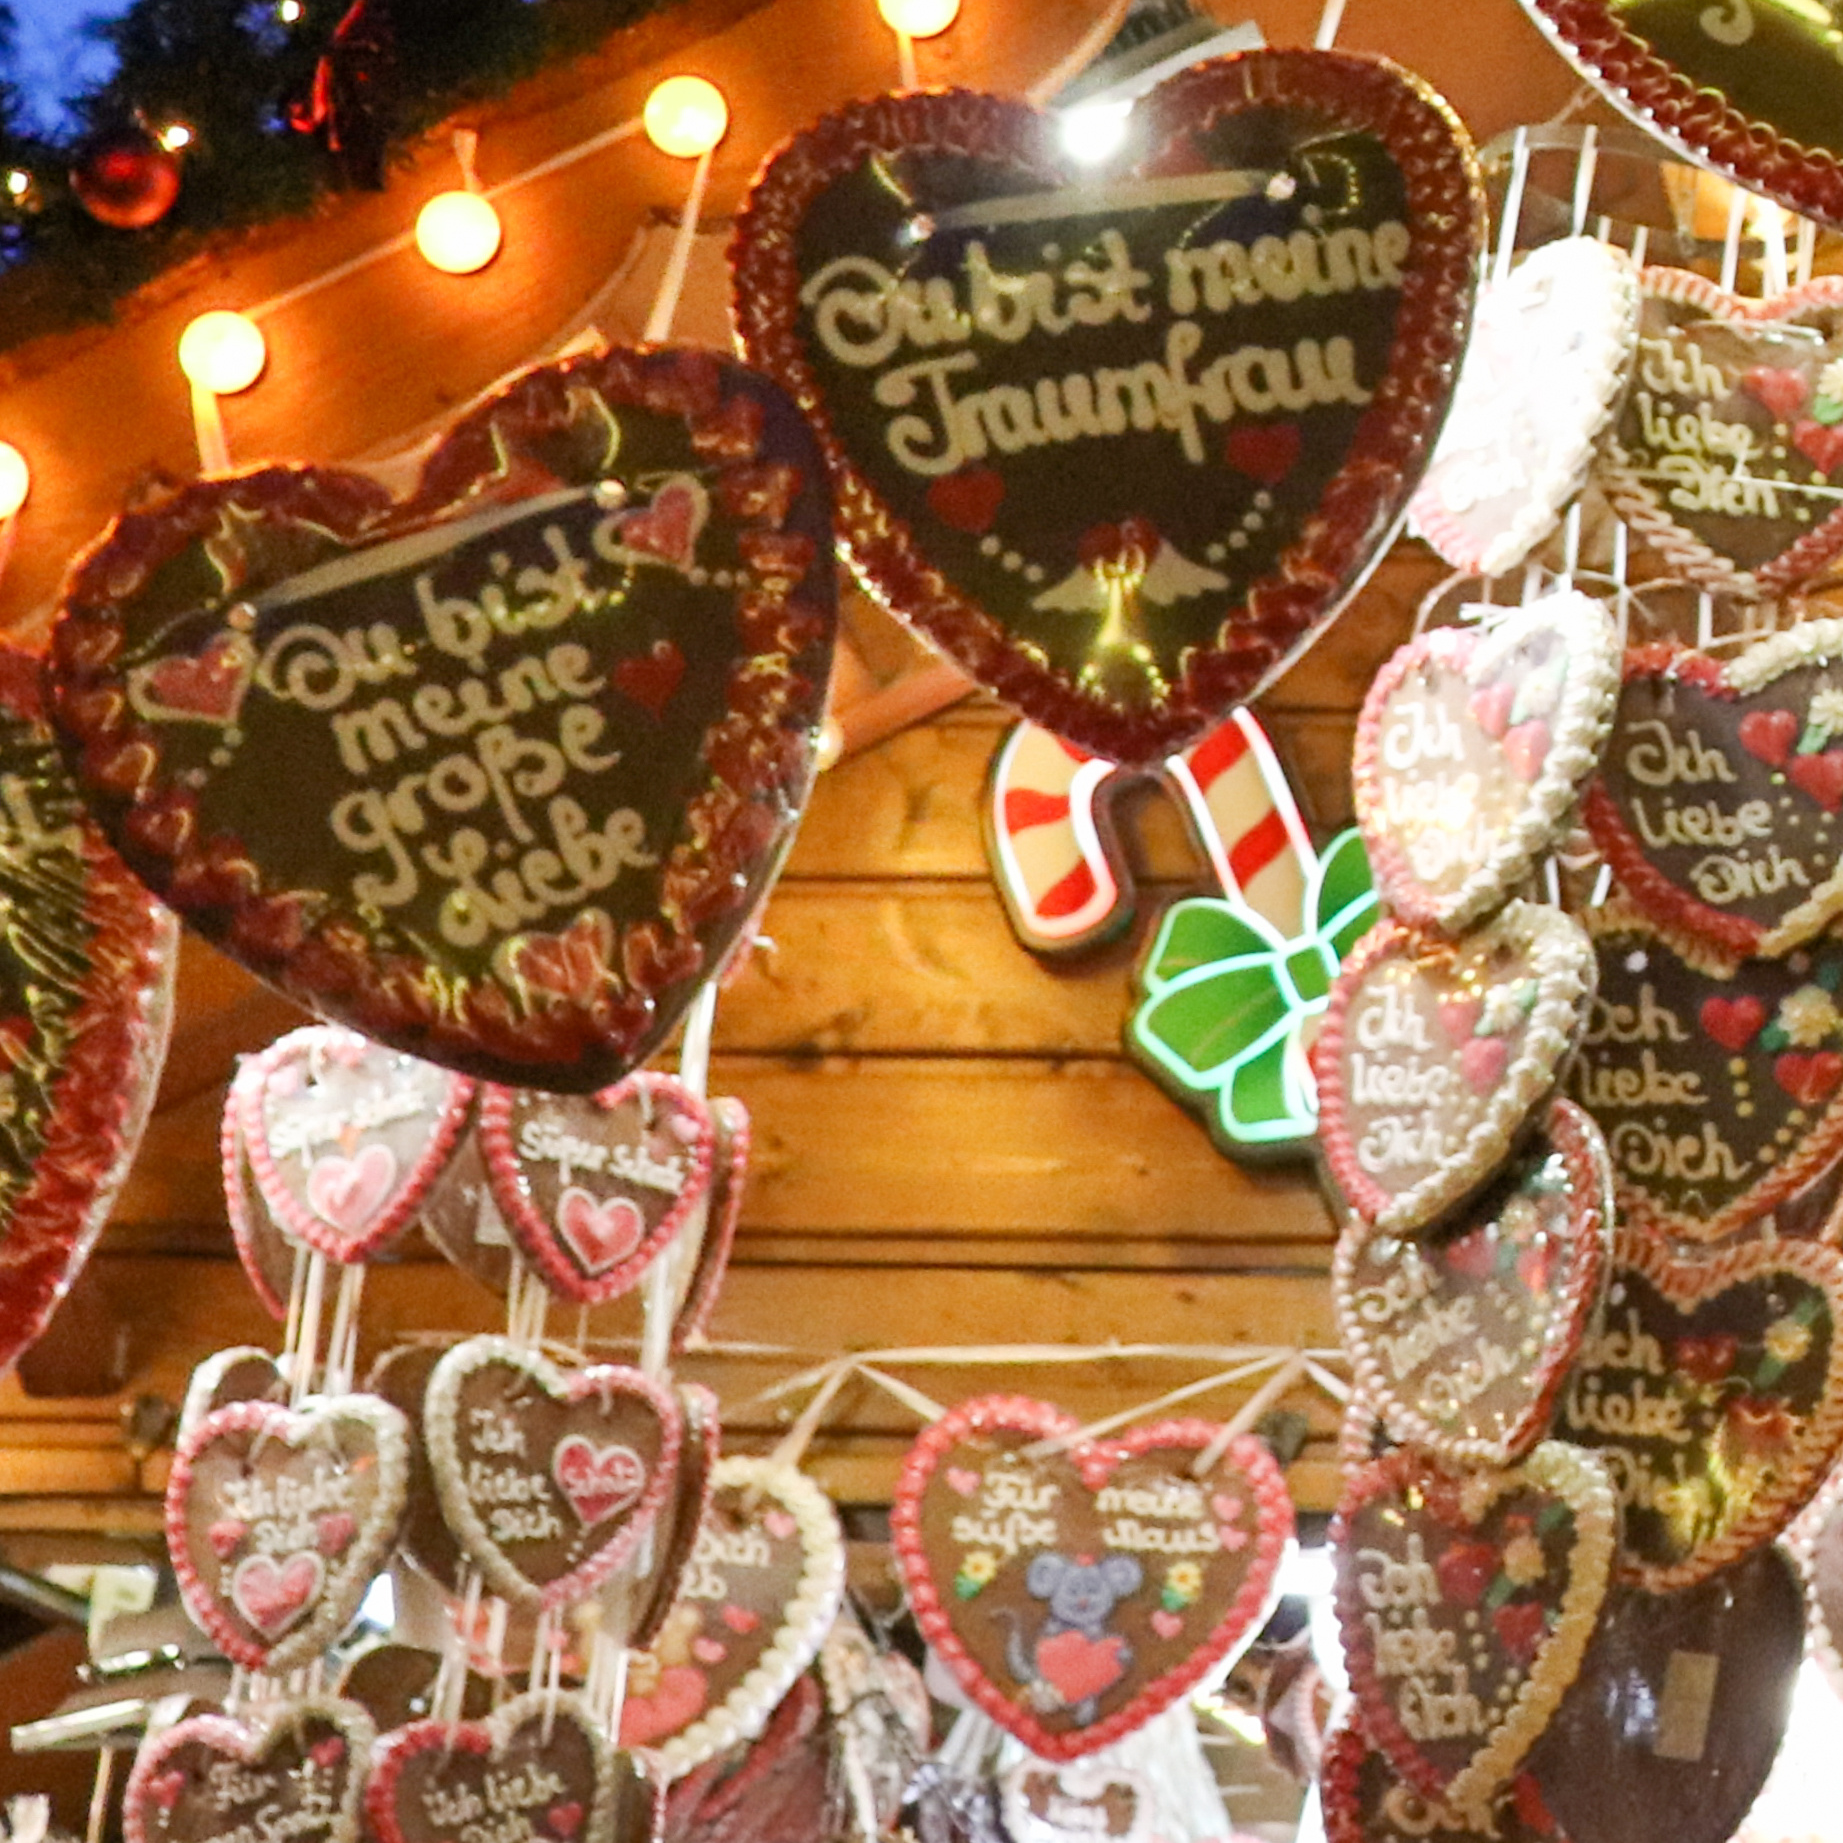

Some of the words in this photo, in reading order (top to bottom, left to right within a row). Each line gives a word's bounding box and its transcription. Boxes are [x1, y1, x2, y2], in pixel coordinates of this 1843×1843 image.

[800, 255, 972, 365] Du
[967, 228, 1153, 342] bist
[1166, 220, 1411, 314] meine
[875, 322, 1373, 475] Traumfrau
[1638, 338, 1733, 400] Ich
[1636, 390, 1766, 461] liebe
[1648, 456, 1782, 520] Dich
[257, 624, 417, 710] Du
[414, 524, 598, 664] bist
[333, 642, 608, 774] meine
[1382, 699, 1465, 771] Ich
[1626, 718, 1739, 789] Ich
[331, 704, 621, 906] große
[1630, 794, 1775, 850] liebe
[425, 794, 660, 948] Liebe
[1690, 846, 1810, 906] Dich
[1355, 983, 1434, 1054] Ich
[1350, 1053, 1454, 1107] liebe
[1574, 1047, 1711, 1108] liebe
[1611, 1113, 1755, 1182] Dich
[1564, 1370, 1694, 1444] liebe
